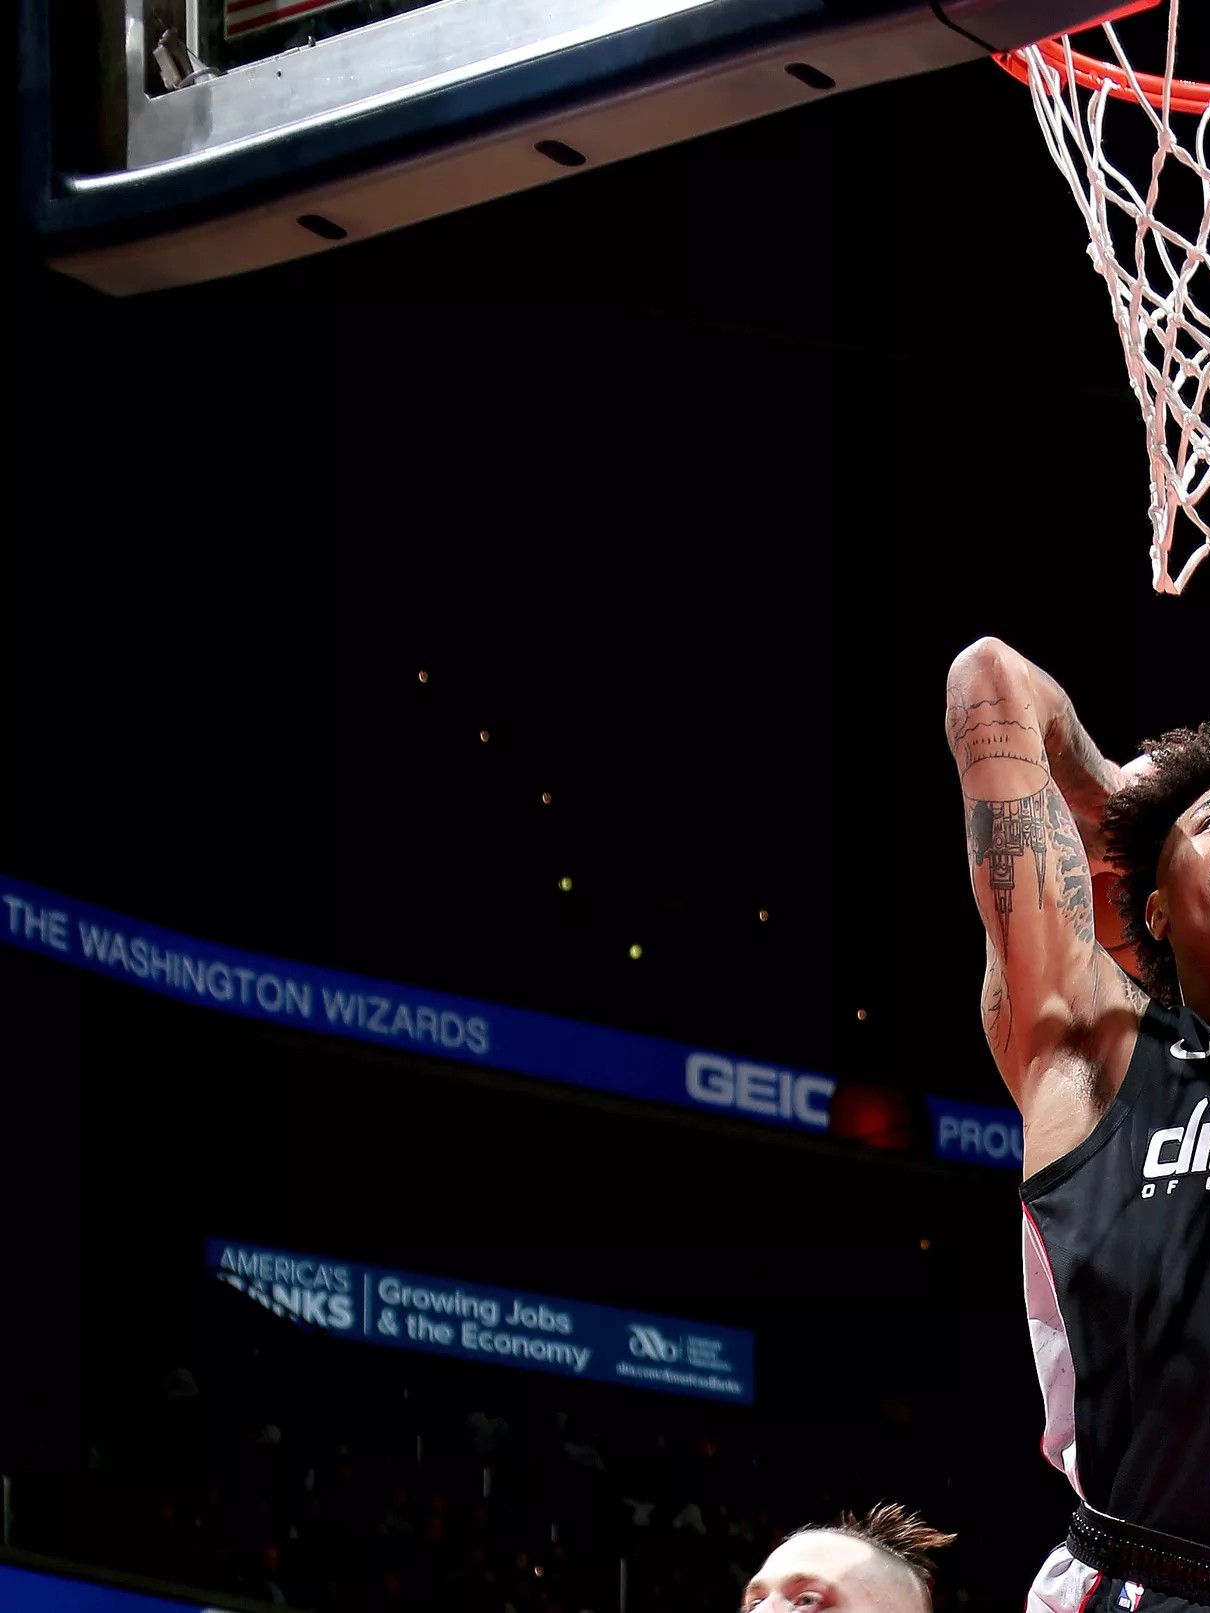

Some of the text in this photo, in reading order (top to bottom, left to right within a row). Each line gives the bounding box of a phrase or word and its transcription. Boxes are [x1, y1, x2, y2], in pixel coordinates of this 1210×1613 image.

[3, 895, 489, 1055] THE WASHINGTON WIZARDS
[685, 1052, 836, 1127] GEIC
[938, 1114, 1023, 1162] PROU
[1141, 1179, 1179, 1199] OF
[220, 1248, 349, 1293] AMERICA'S
[378, 1277, 572, 1335] Growing Jobs
[377, 1307, 590, 1373] & the Economy
